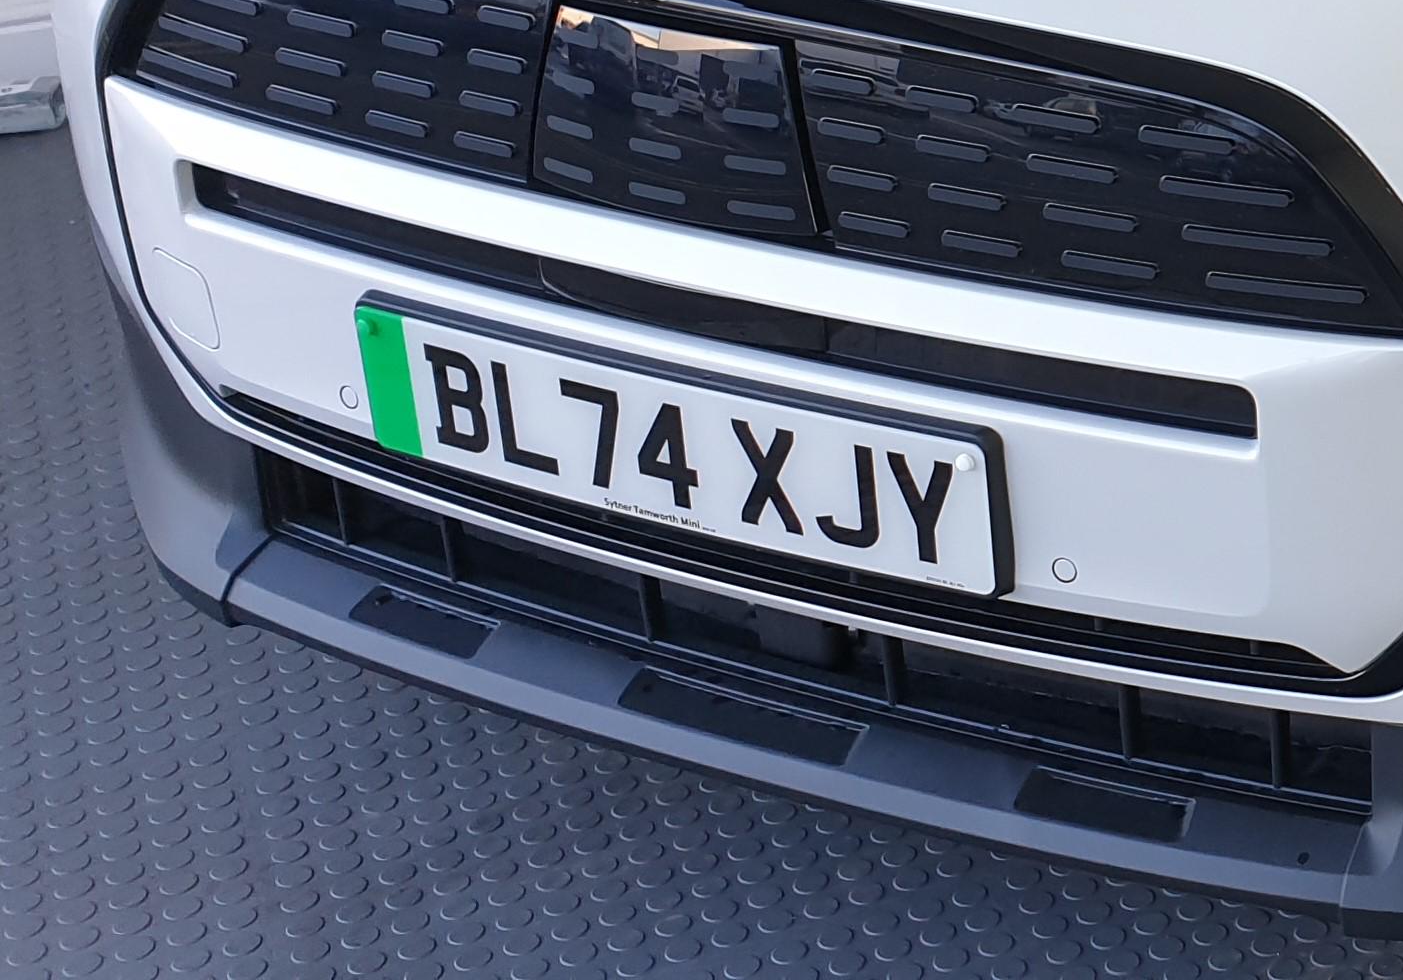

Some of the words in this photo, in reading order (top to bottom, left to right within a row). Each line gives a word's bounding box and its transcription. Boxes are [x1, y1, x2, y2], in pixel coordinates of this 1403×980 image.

[424, 342, 700, 509] BL74
[731, 417, 953, 564] XJY
[603, 497, 633, 512] Sytner
[633, 505, 679, 524] Tamworth
[680, 516, 701, 530] Mini
